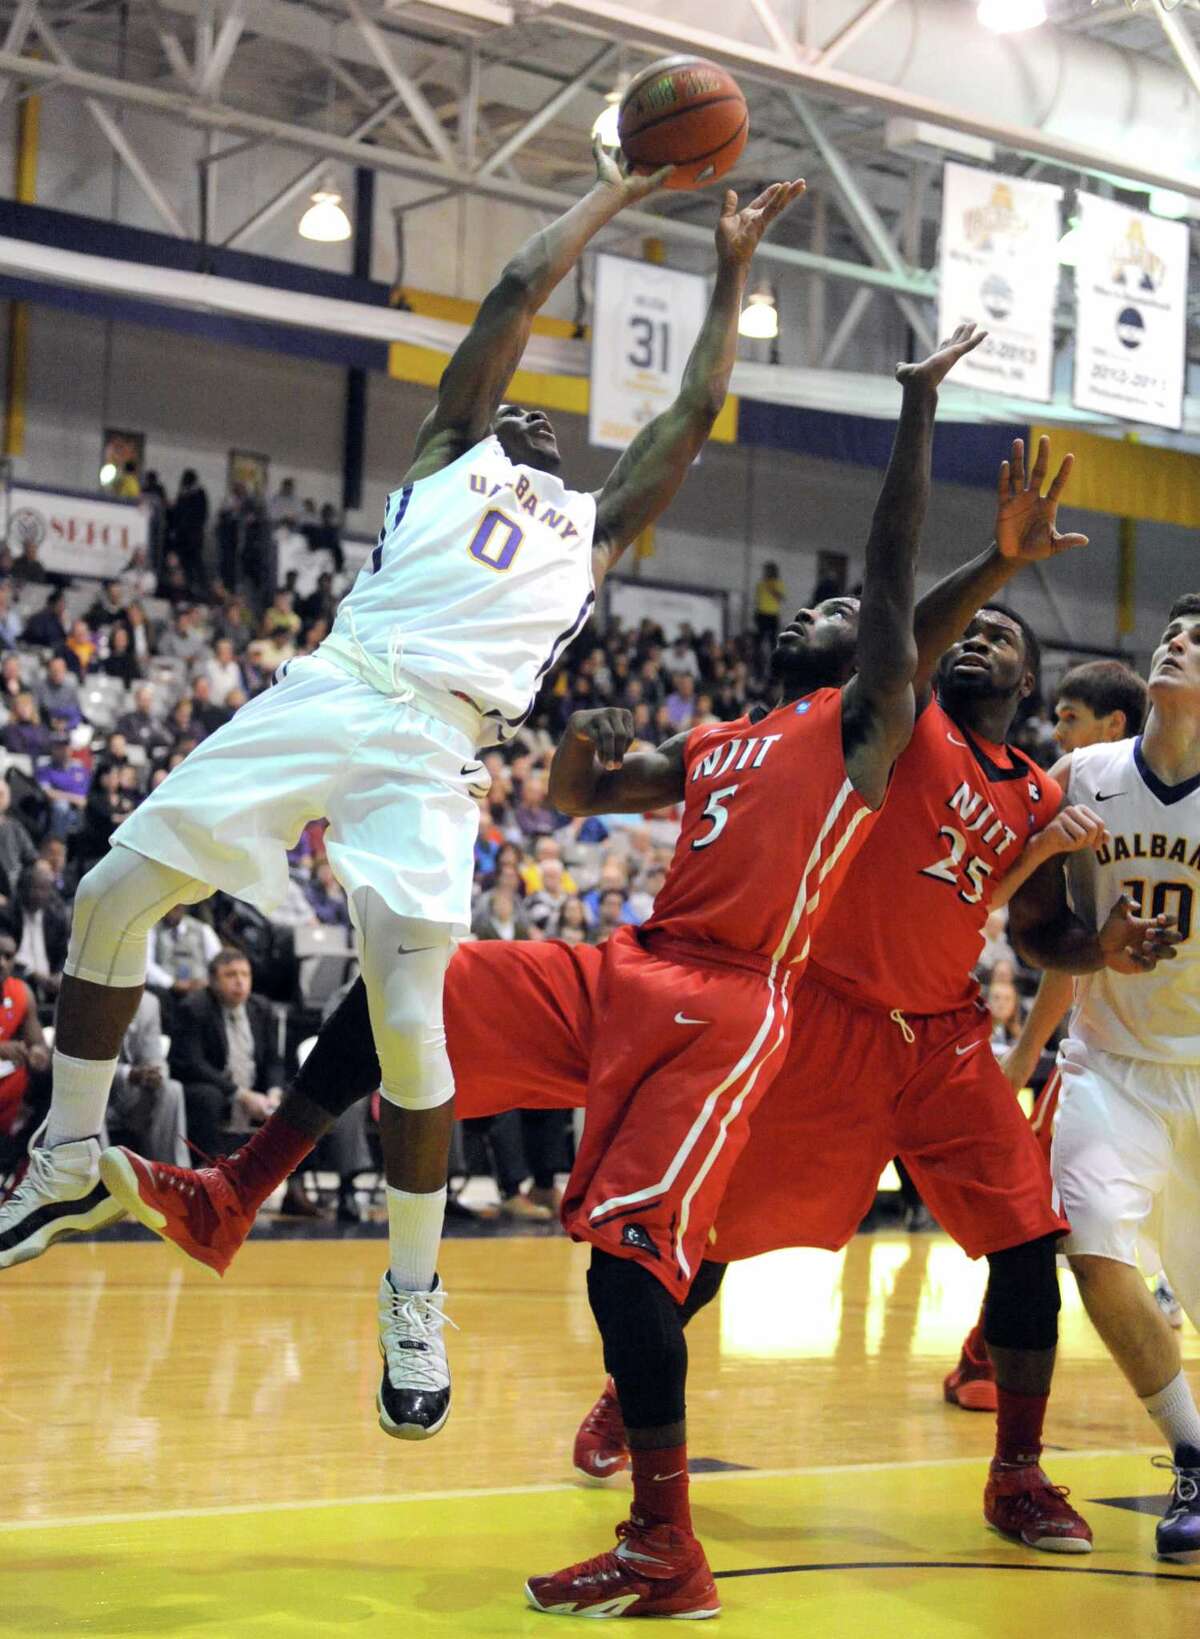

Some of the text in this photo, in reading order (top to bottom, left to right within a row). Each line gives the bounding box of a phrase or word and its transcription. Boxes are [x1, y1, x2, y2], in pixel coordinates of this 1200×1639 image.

[627, 314, 670, 373] 31
[467, 506, 527, 573] 0
[469, 473, 580, 540] UBANY
[692, 733, 784, 784] NJIT
[691, 783, 740, 851] 5
[947, 780, 1018, 856] NJIT
[918, 825, 994, 905] 25
